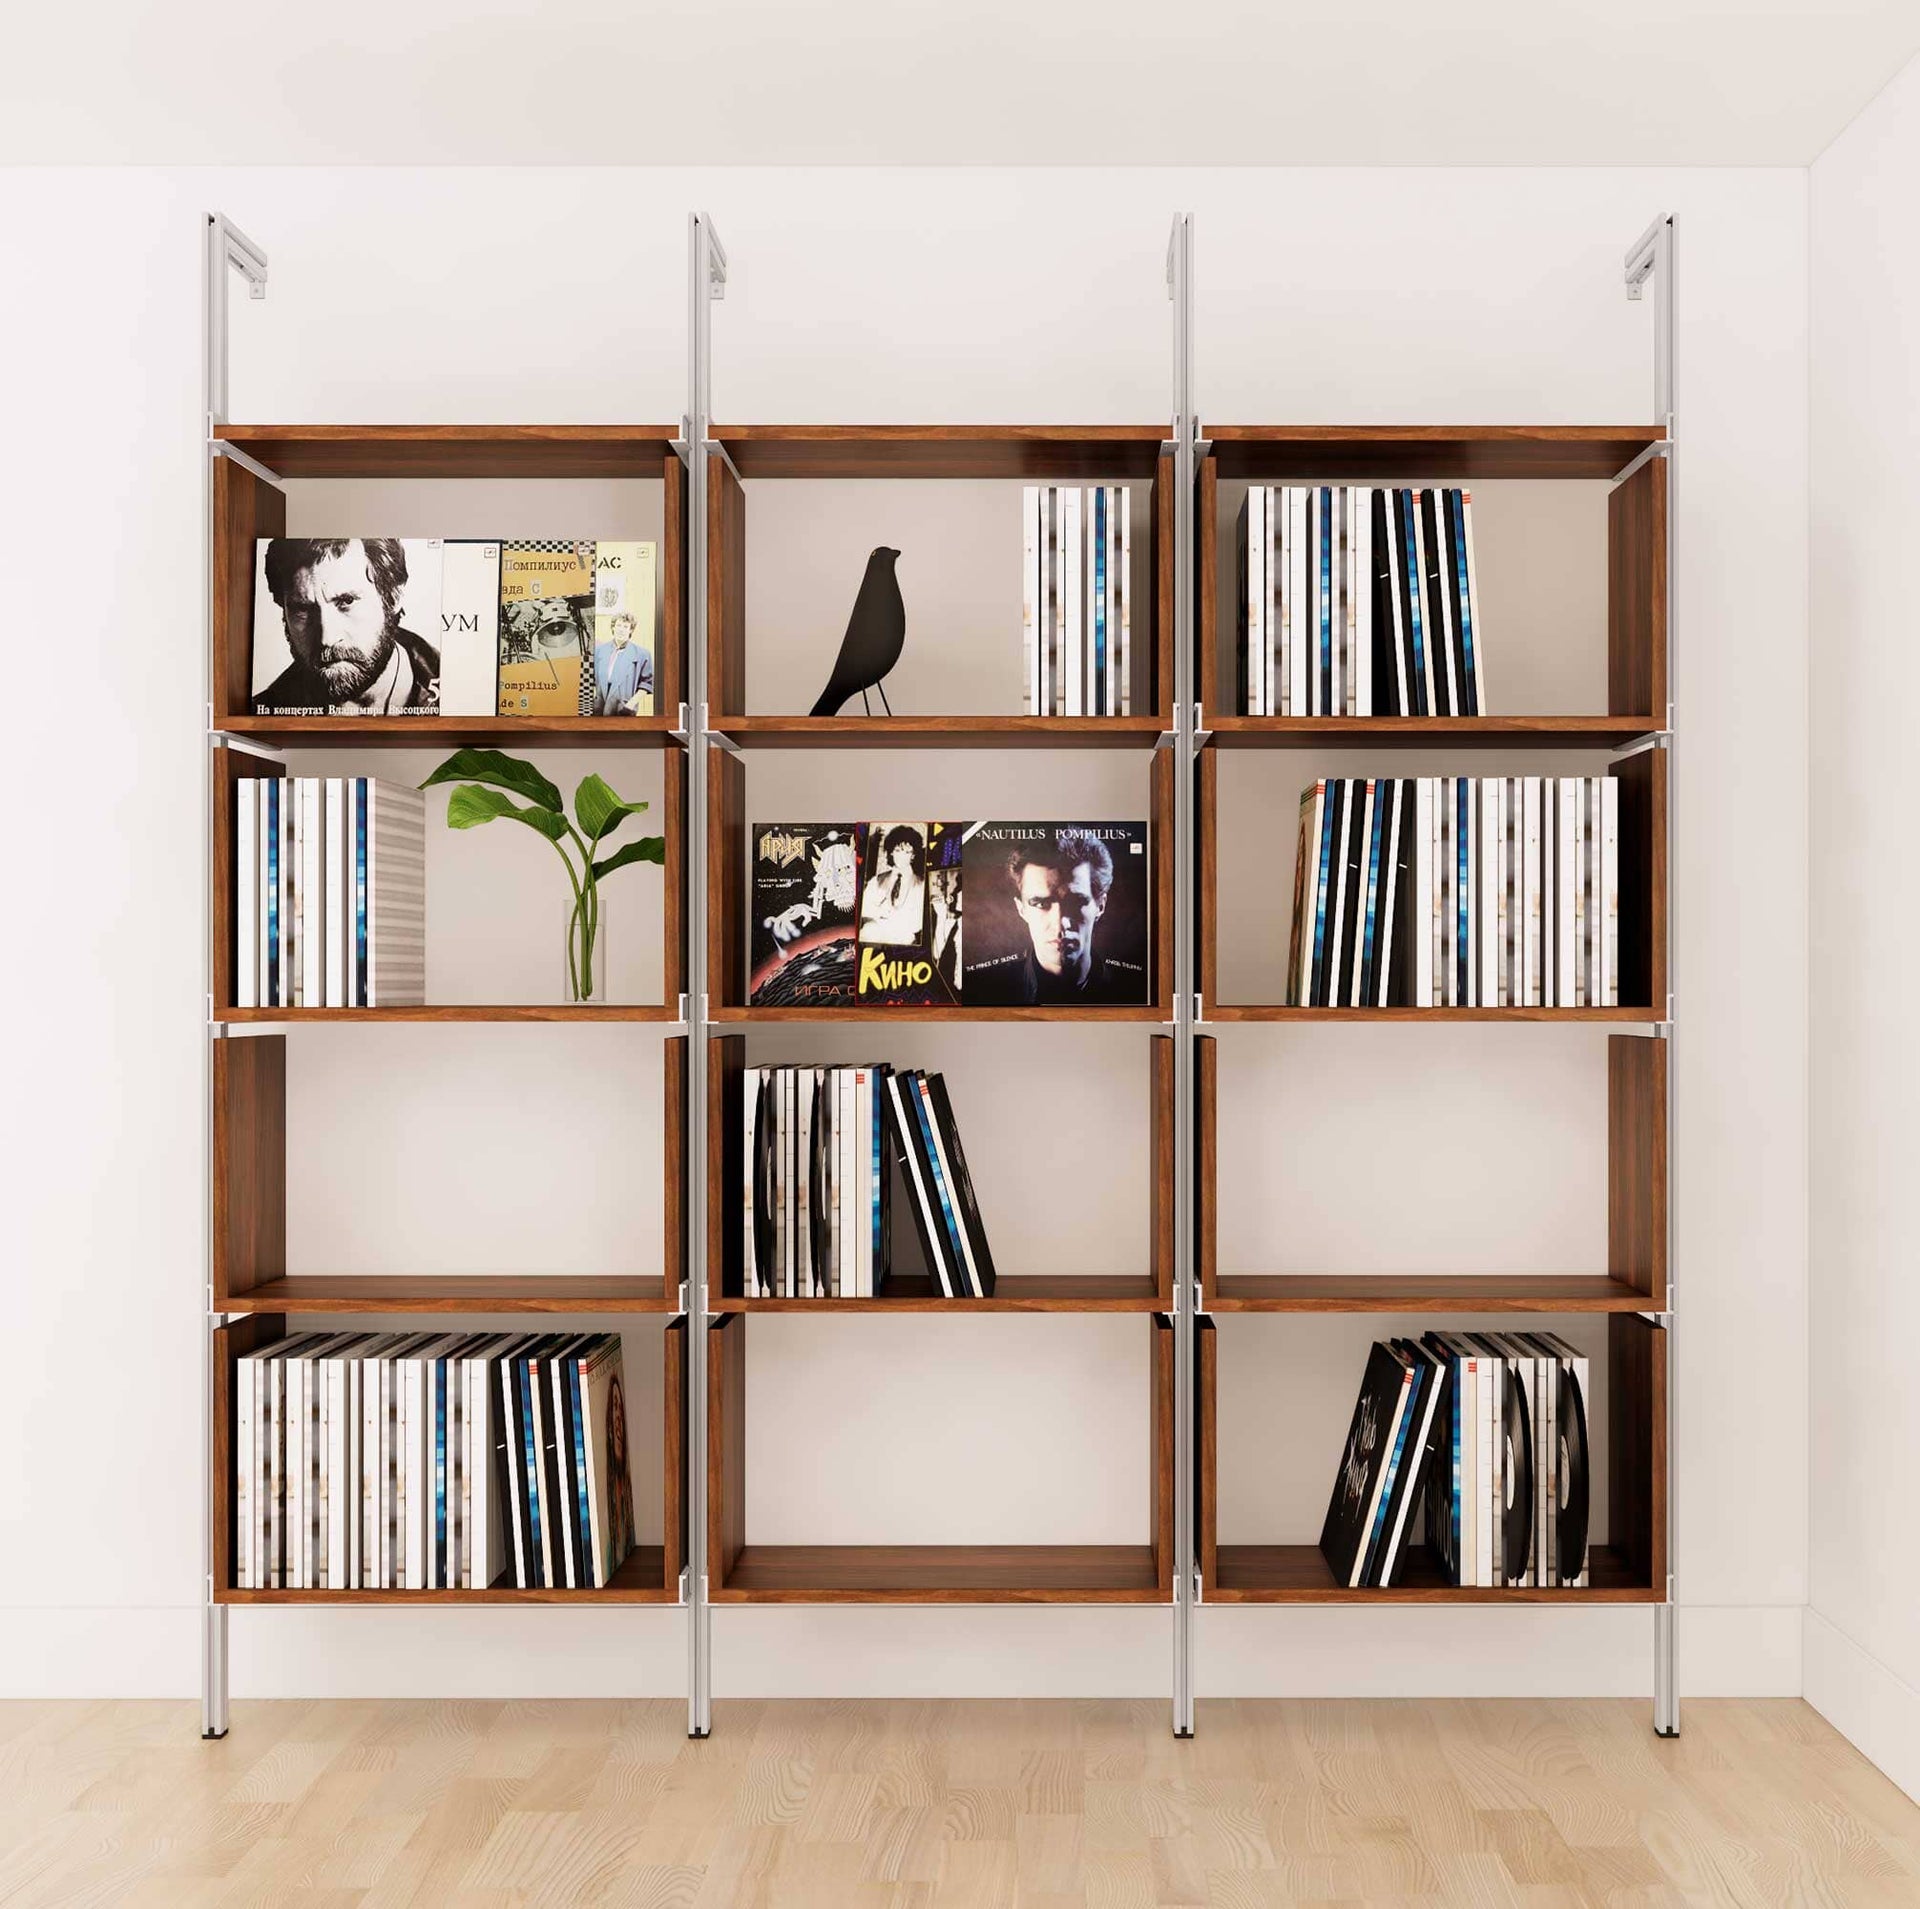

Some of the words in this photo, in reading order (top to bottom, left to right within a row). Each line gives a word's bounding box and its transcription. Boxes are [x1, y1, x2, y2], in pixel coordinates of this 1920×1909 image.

[504, 559, 577, 573] Помпилиус
[597, 556, 622, 569] АС
[441, 614, 479, 632] УМ
[427, 677, 440, 703] 5
[520, 698, 528, 708] S
[257, 704, 270, 716] На
[273, 706, 324, 717] концертах
[389, 704, 440, 717] Высоцкого
[795, 984, 841, 997] ИГРА
